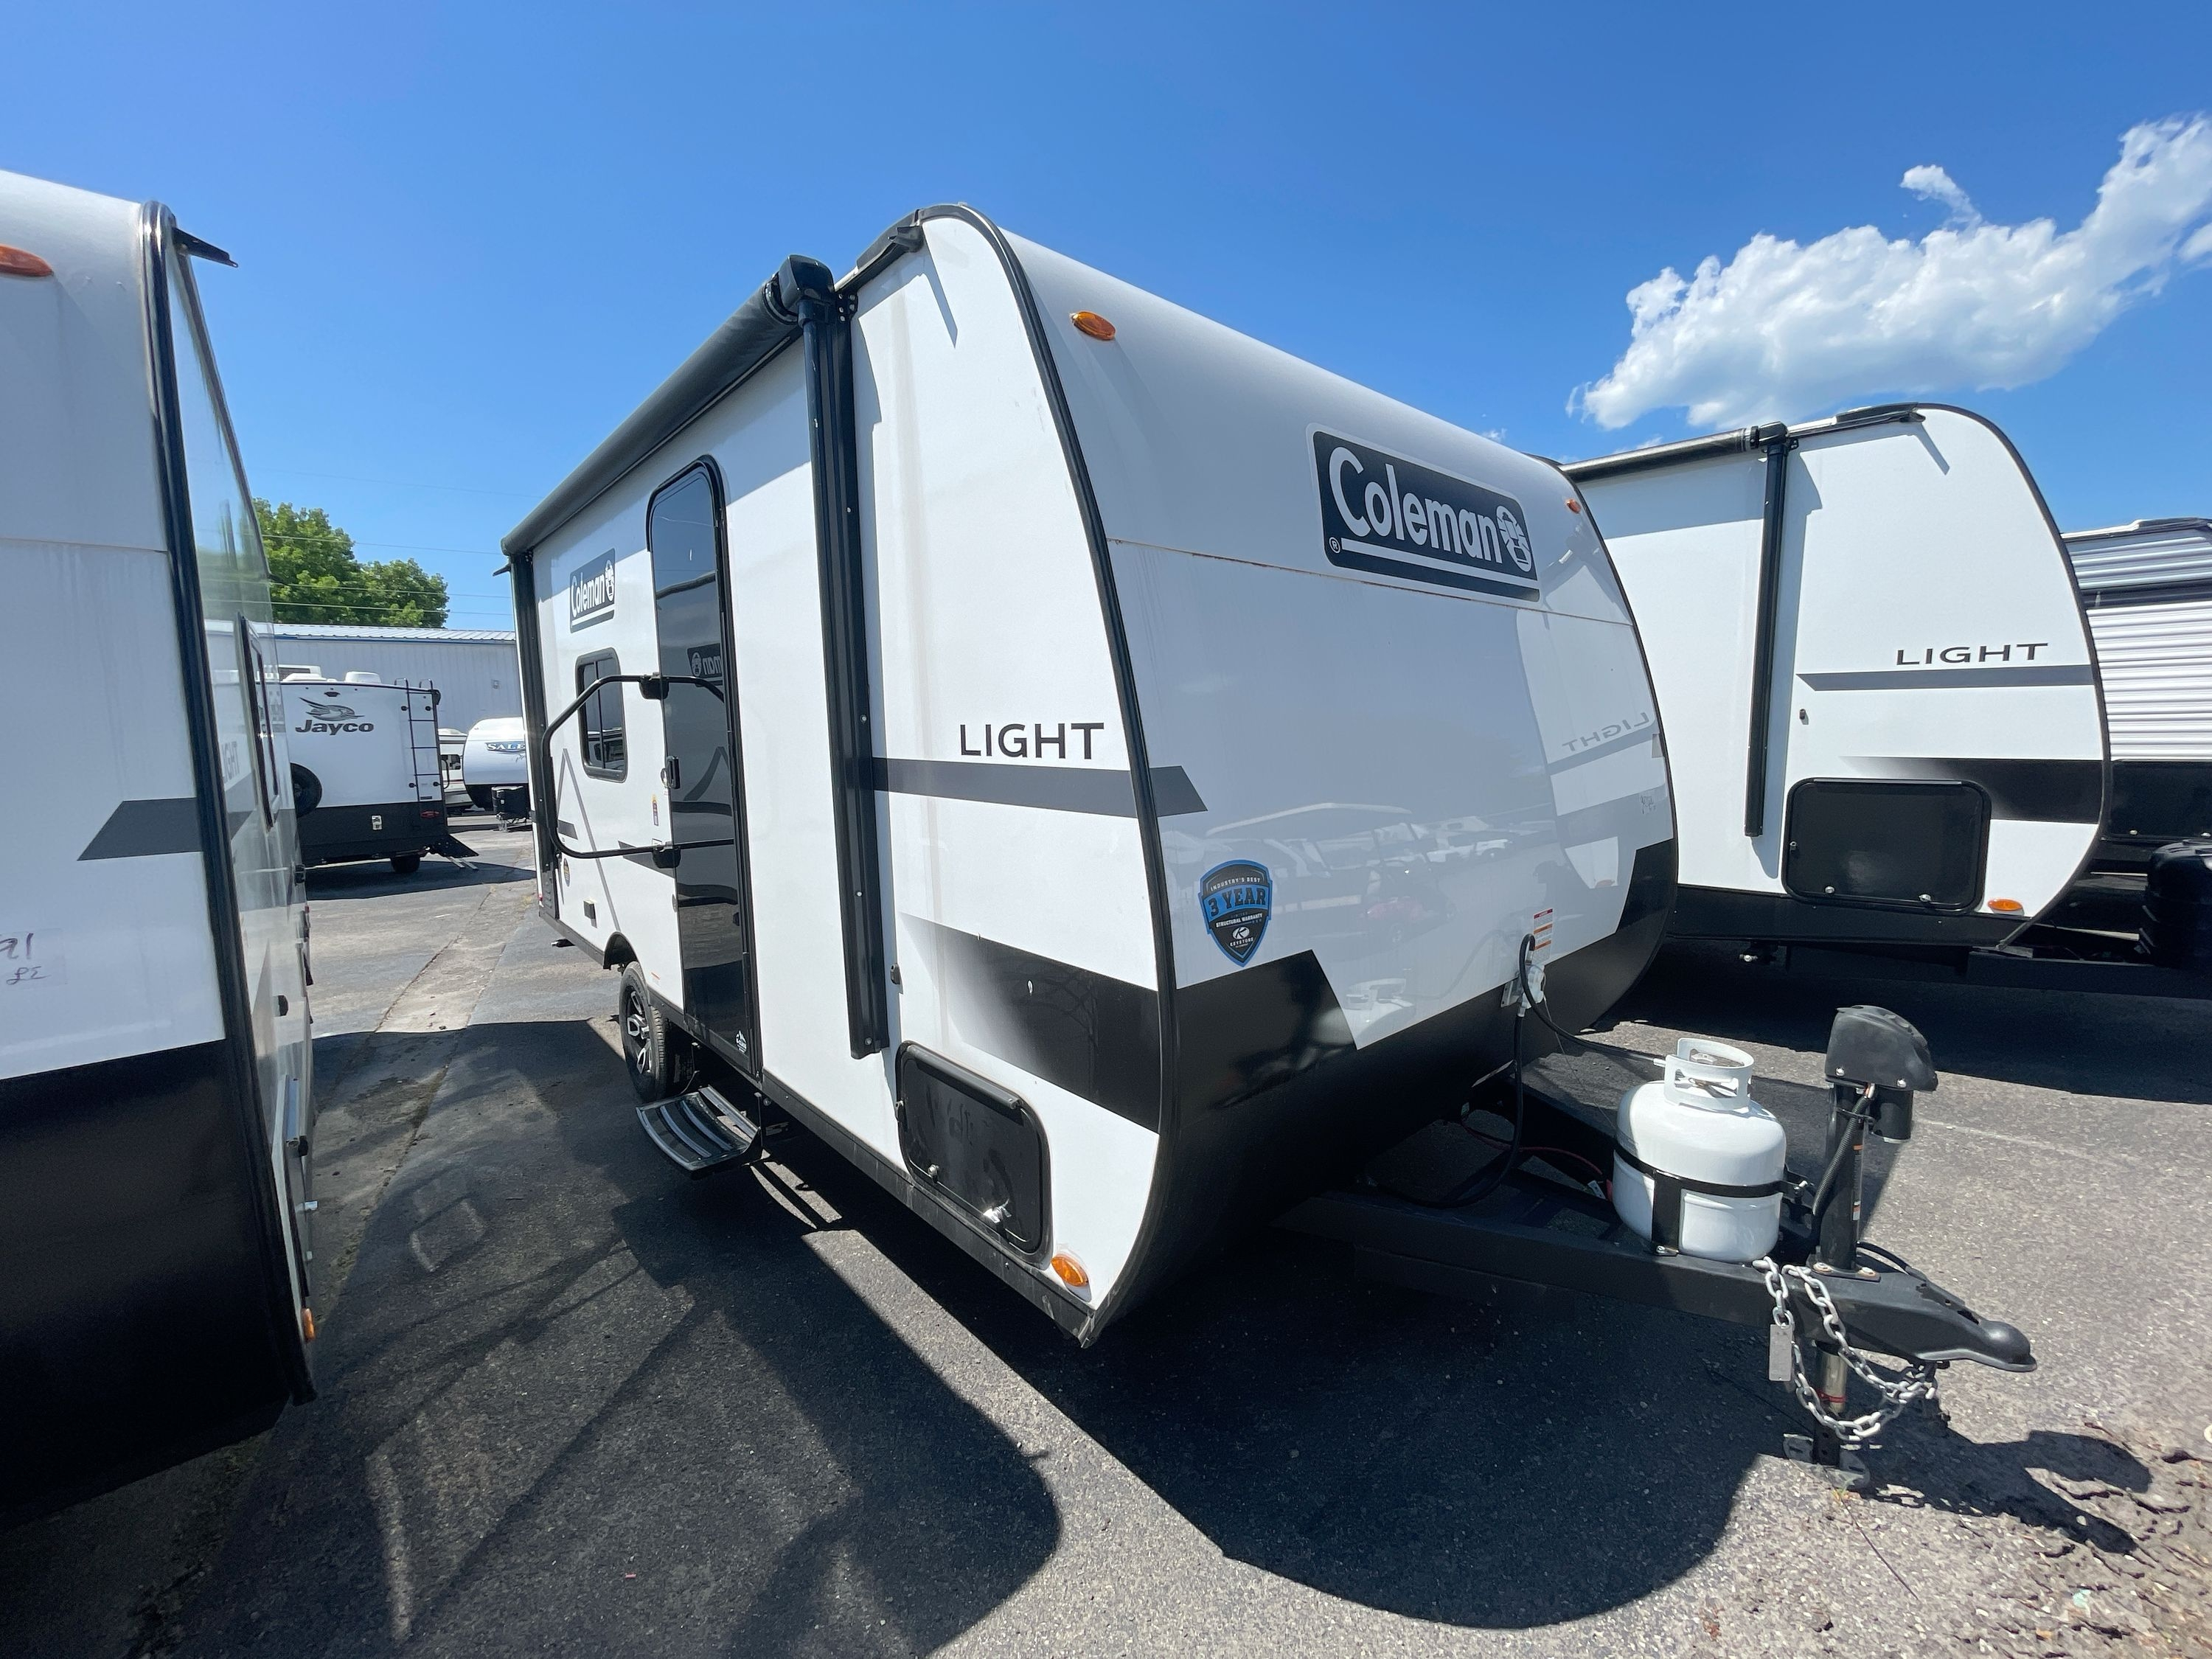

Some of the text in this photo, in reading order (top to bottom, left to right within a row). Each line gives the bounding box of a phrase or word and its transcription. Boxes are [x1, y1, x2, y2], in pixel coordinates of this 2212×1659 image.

[1329, 447, 1503, 564] Coleman
[571, 571, 605, 617] Coleman
[1896, 642, 2048, 666] LIGHT
[295, 720, 374, 735] Jayco
[960, 722, 1105, 759] LIGHT
[1210, 877, 1245, 891] INDUSTRY'S
[1208, 887, 1266, 917] 3 YEAR
